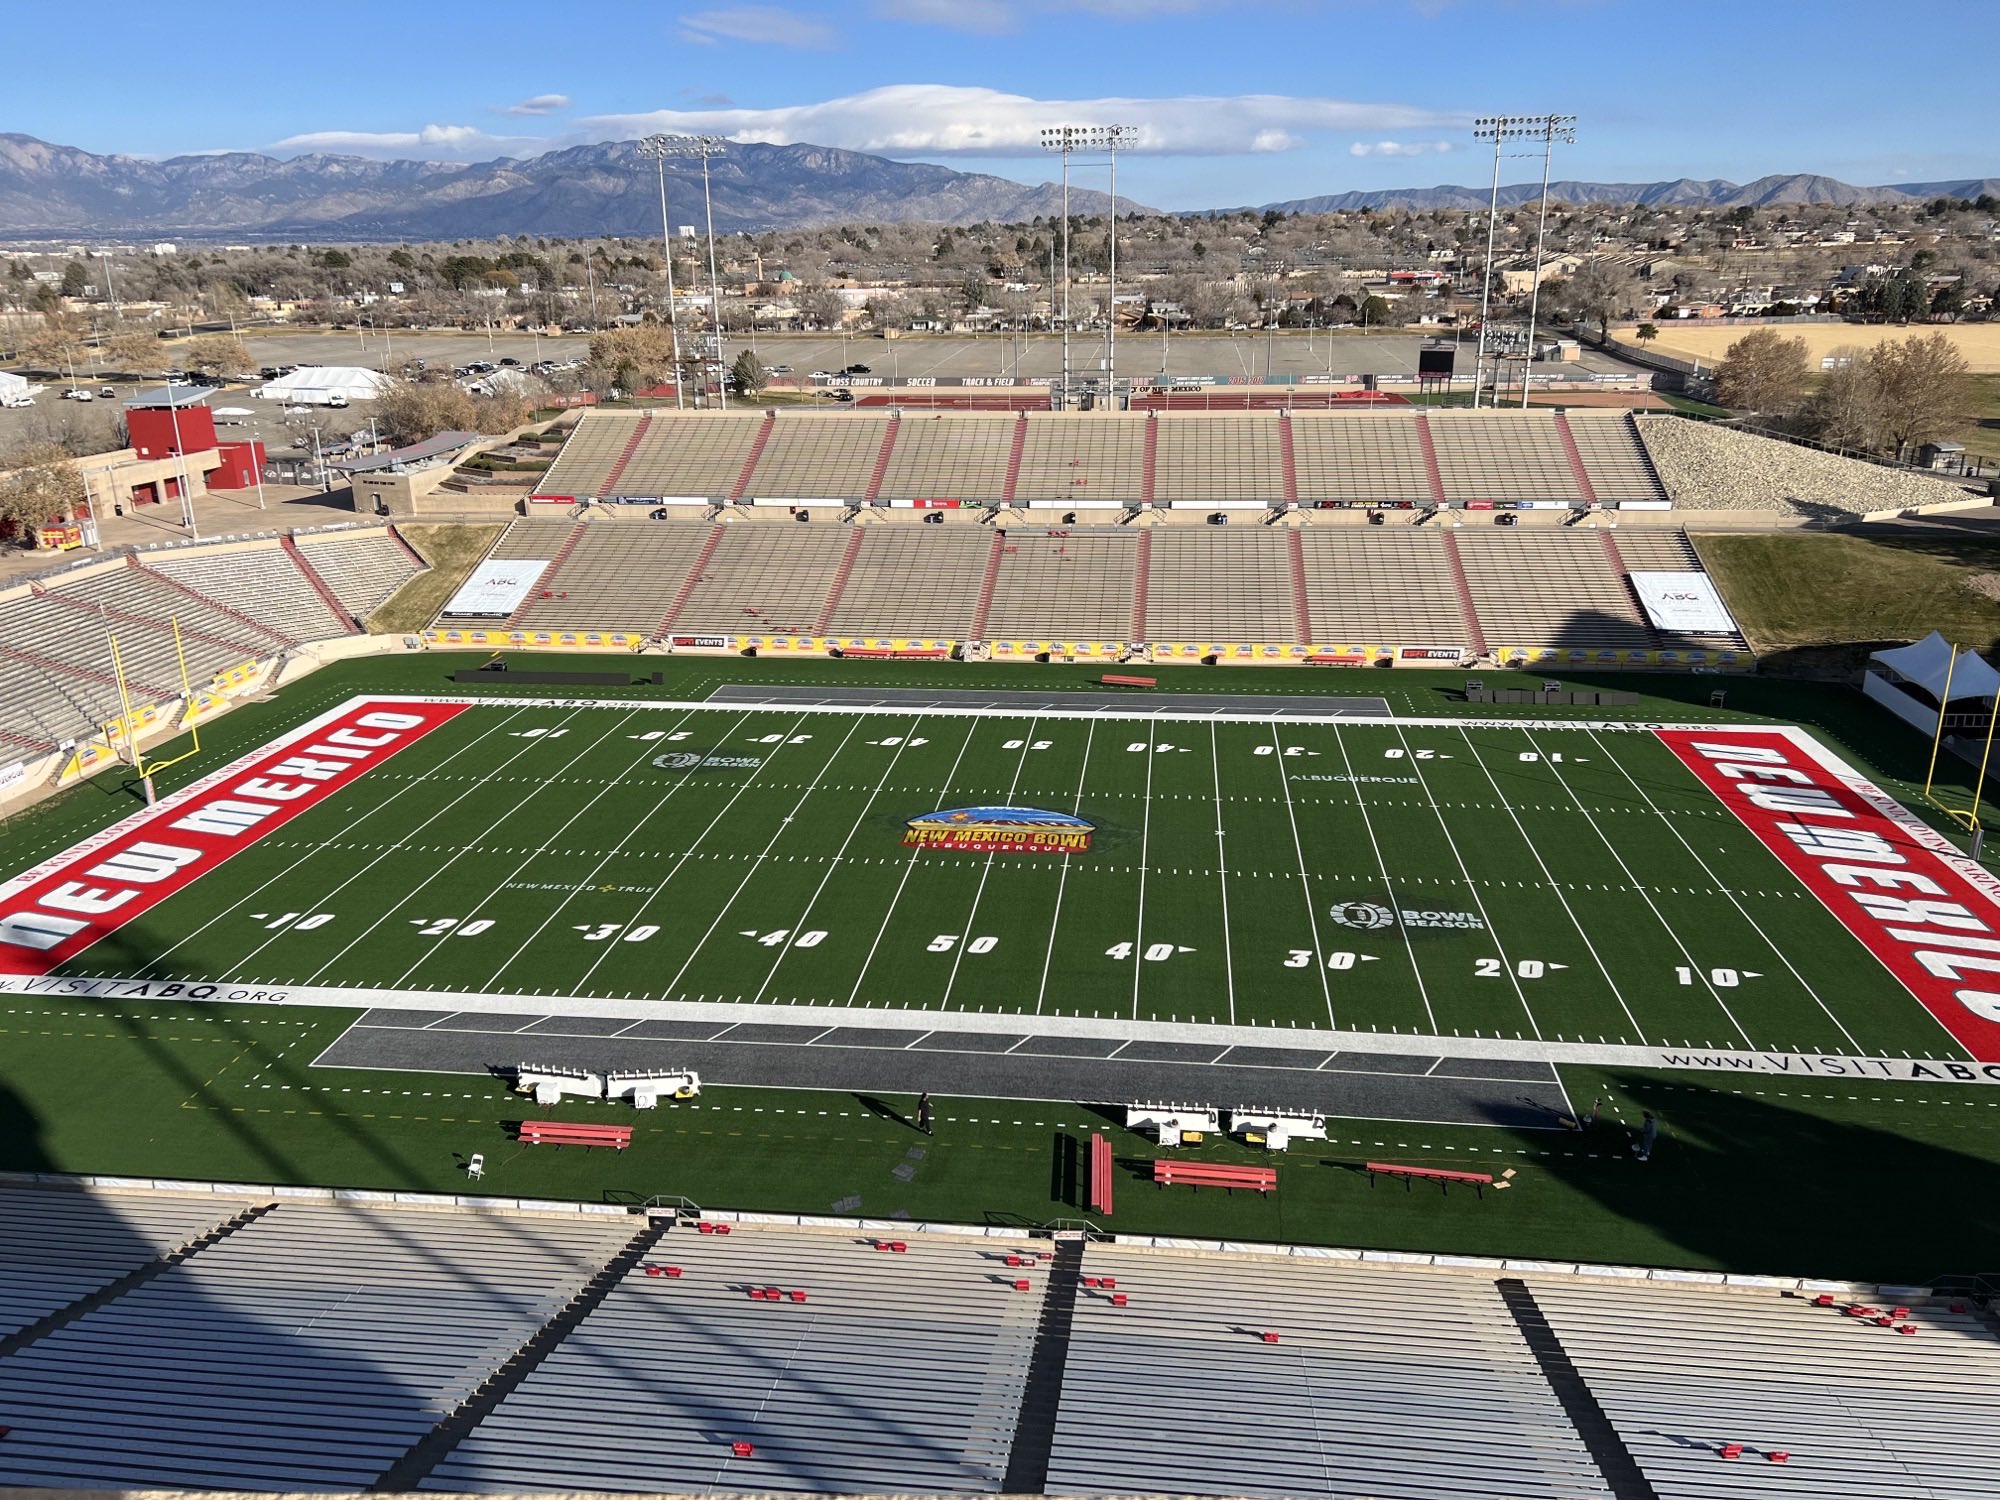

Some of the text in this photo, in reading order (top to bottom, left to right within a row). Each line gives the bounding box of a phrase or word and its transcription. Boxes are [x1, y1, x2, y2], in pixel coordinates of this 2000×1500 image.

[827, 378, 883, 386] CROSS COUNTRY
[907, 378, 936, 386] SOCCER
[962, 378, 1014, 386] TRACK & FIELD
[673, 637, 724, 647] ESPN EVENTS
[1403, 649, 1460, 659] ESPN EVENTS
[168, 711, 426, 837] MEXICO
[1289, 775, 1419, 784] ALBUQUERQUE
[1689, 741, 1856, 818] NEW
[904, 830, 1088, 849] NEW MEXICO BOWL
[919, 843, 1066, 852] ALBUQUERQUE
[540, 884, 597, 892] MEXICO
[264, 912, 335, 931] 10
[1401, 910, 1482, 922] BOWL
[1404, 919, 1484, 929] SEASON
[417, 918, 496, 936] 20
[583, 924, 661, 942] 30
[758, 929, 829, 947] 40
[926, 935, 999, 954] 50
[1105, 942, 1174, 961] 40
[1283, 949, 1356, 970] 30
[1474, 958, 1545, 979] 20
[1675, 966, 1740, 987] 10
